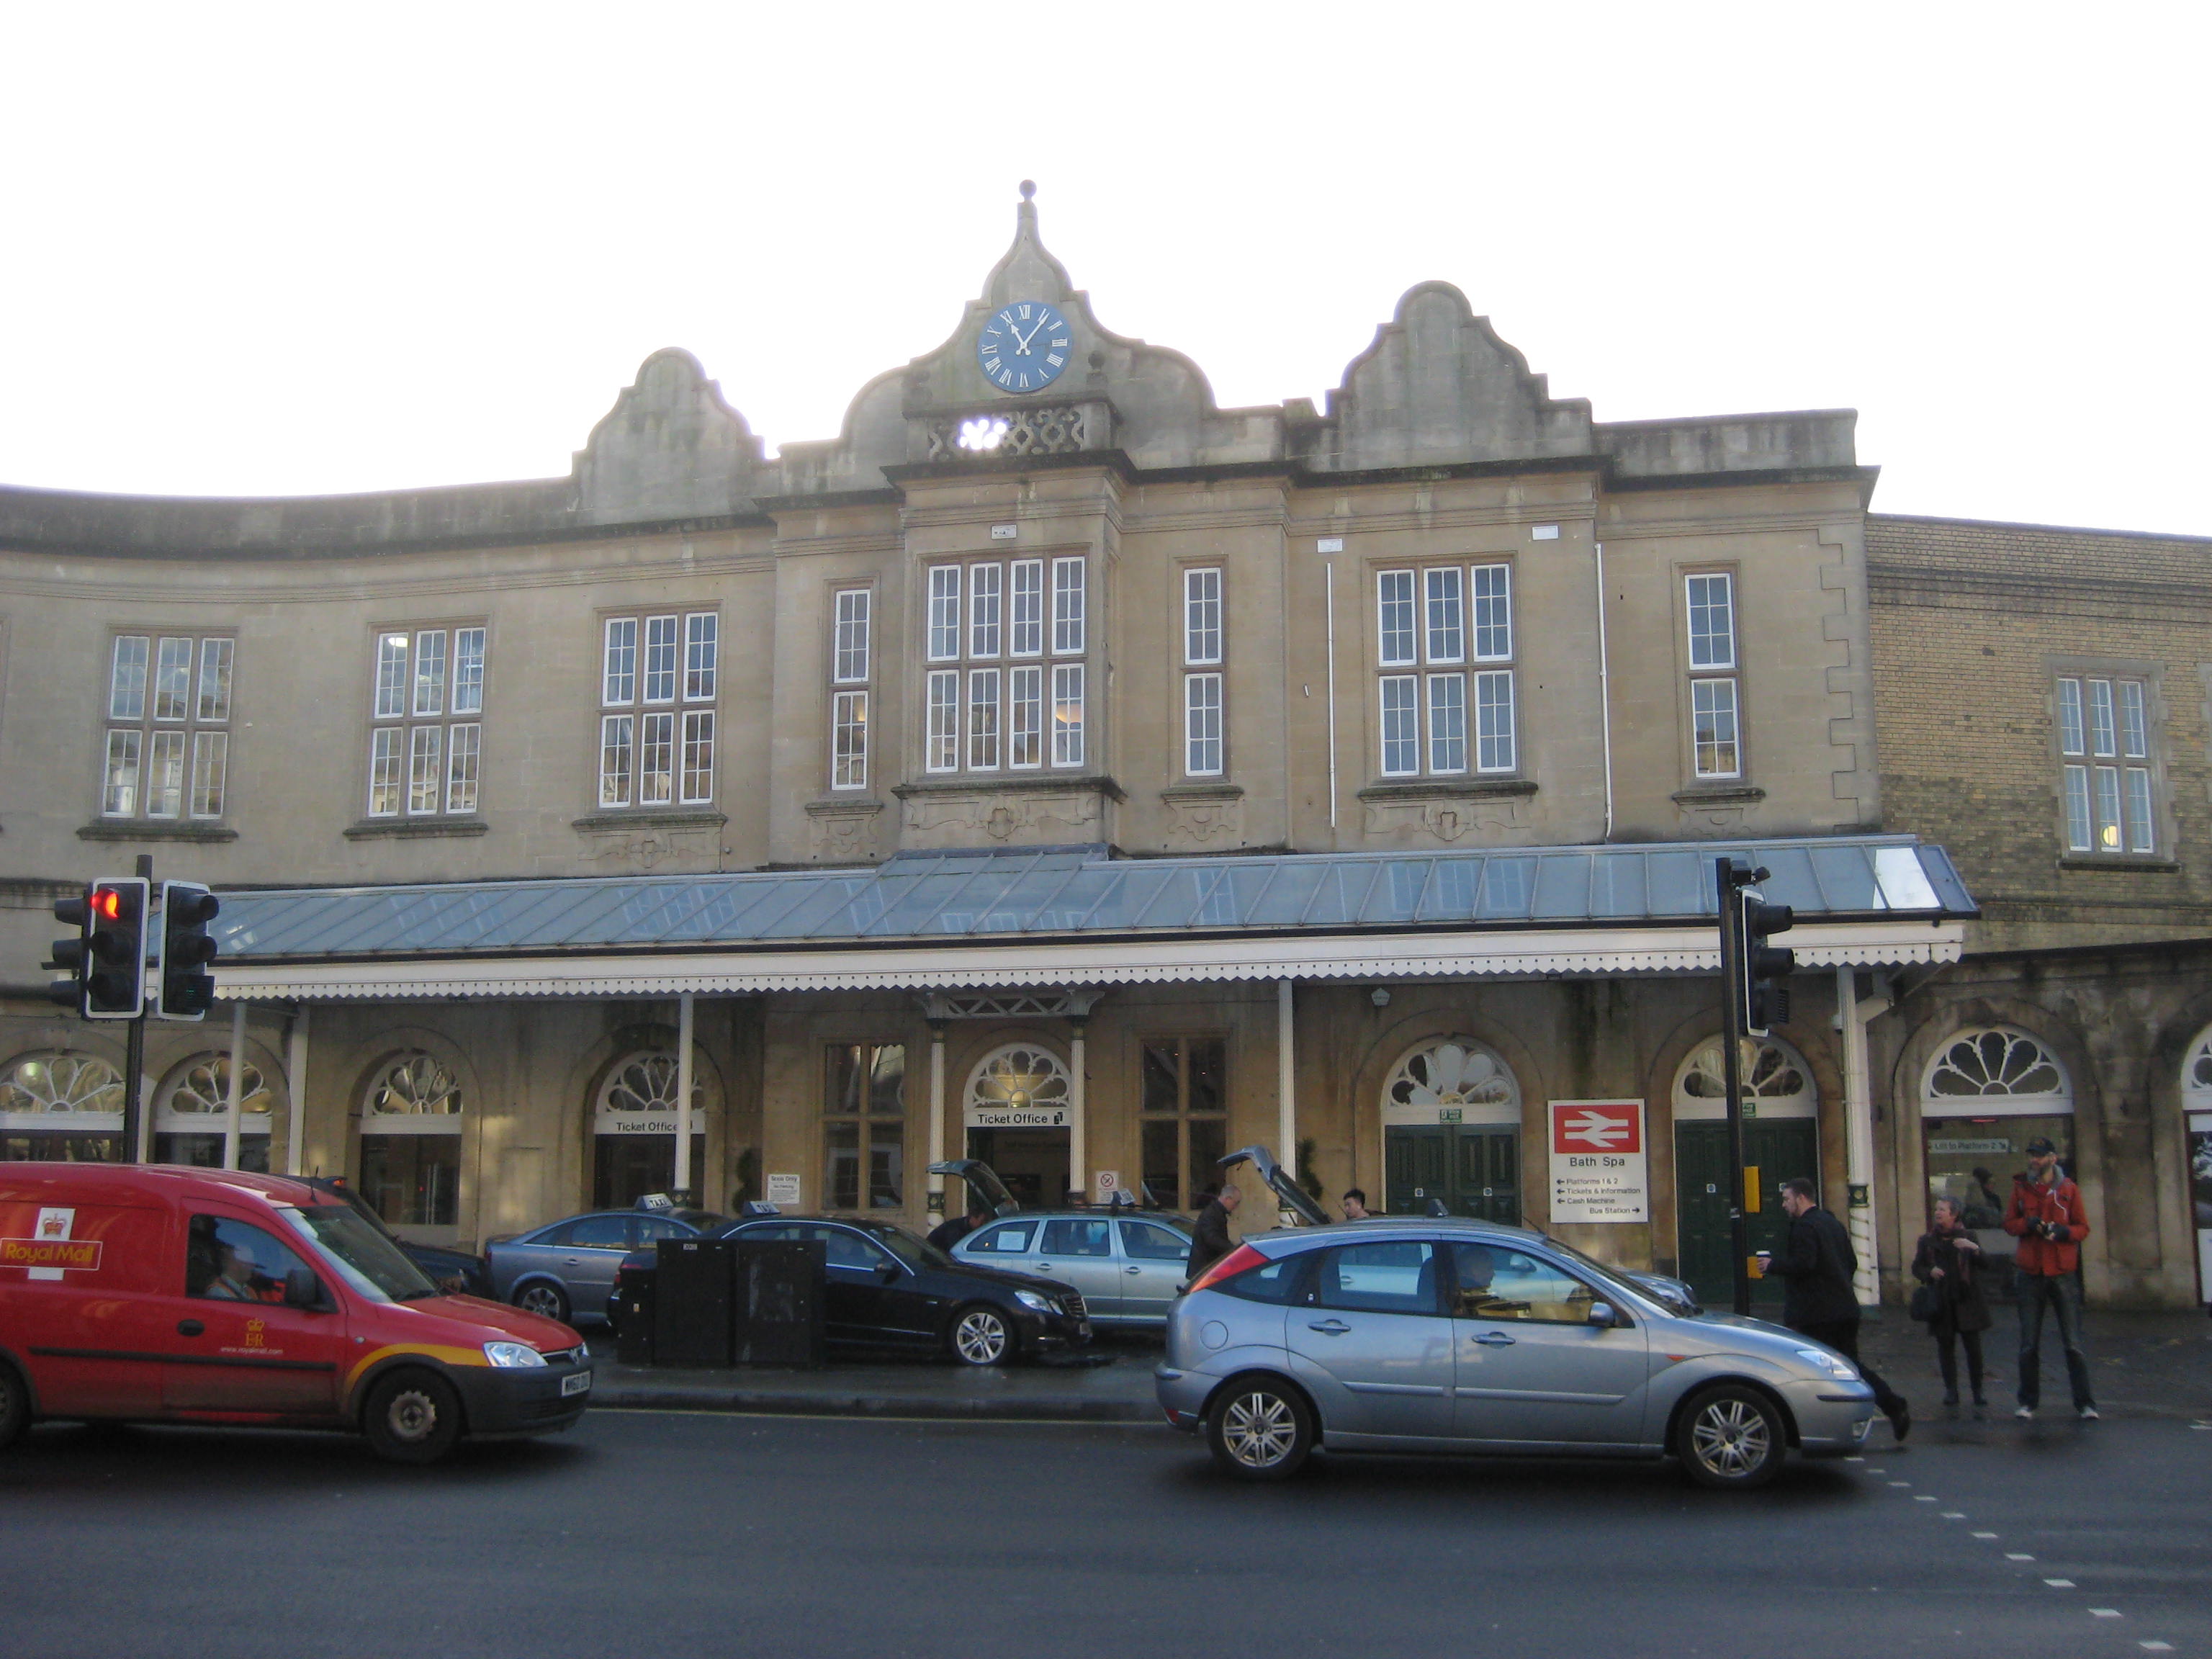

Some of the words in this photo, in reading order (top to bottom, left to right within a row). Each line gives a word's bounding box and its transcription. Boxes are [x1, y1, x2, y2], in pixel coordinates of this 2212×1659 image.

[978, 1114, 1010, 1123] Ticket
[1014, 1113, 1048, 1123] Office
[616, 1122, 645, 1131] Ticket
[1570, 1157, 1596, 1166] Bath
[1603, 1156, 1625, 1167] Spa
[6, 1242, 55, 1263] Royal
[55, 1245, 94, 1262] Mail
